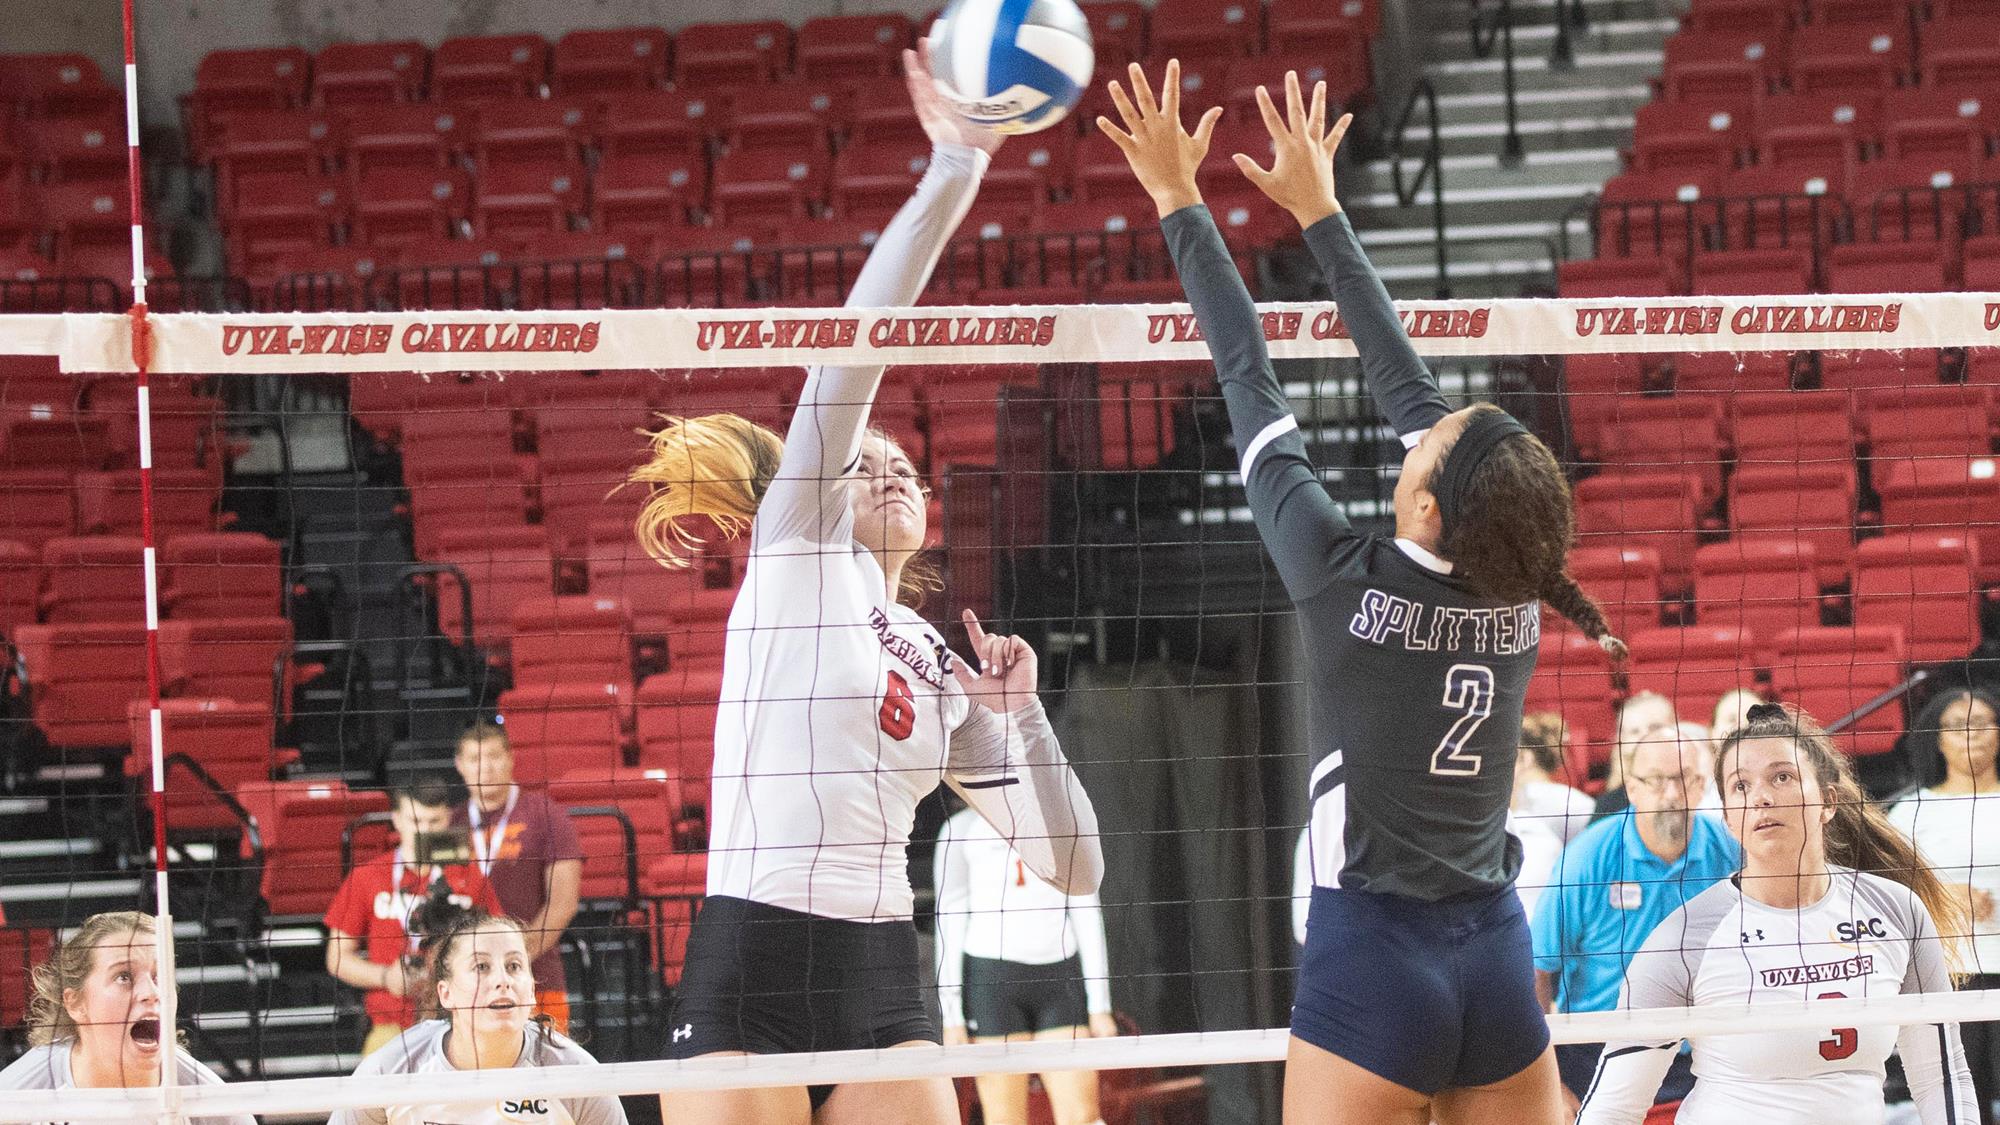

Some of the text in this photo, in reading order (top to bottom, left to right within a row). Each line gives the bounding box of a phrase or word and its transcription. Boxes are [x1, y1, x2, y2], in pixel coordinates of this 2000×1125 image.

[696, 314, 1056, 351] UVA-WISE CAVALIERS
[1575, 302, 1902, 336] UVA-WISE CAVALIERS
[222, 321, 600, 356] UVA-WISE CAVALIERS
[1349, 588, 1541, 655] SPLITTERS
[878, 669, 916, 742] 6
[1429, 663, 1495, 776] 2
[1836, 917, 1887, 942] SAC
[1759, 955, 1874, 988] UVA-WISE
[503, 1098, 549, 1115] SAC
